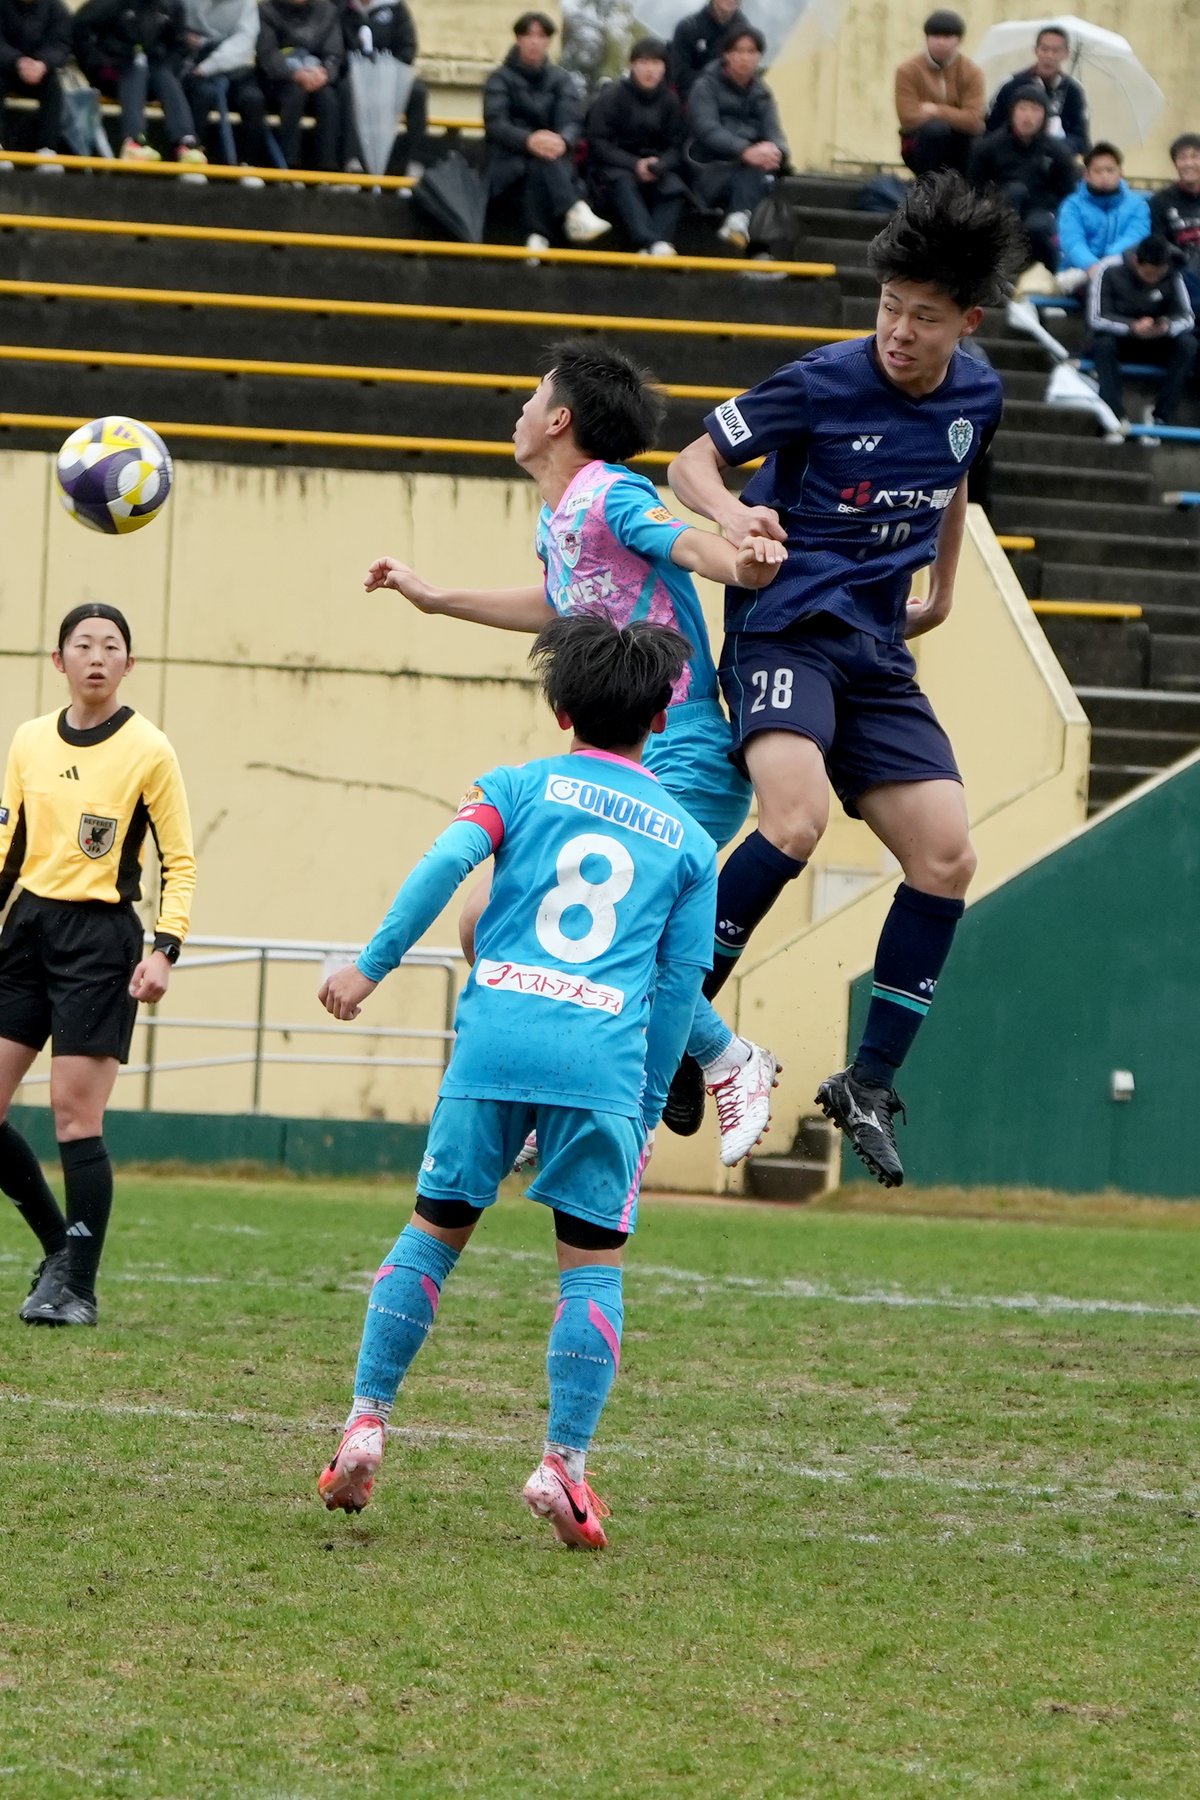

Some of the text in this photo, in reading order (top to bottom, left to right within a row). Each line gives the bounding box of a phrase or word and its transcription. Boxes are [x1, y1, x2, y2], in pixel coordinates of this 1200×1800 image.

[750, 667, 794, 714] 28
[578, 784, 682, 846] ONOKEN
[535, 833, 635, 964] 8
[511, 971, 620, 1012] ベストアメニティ
